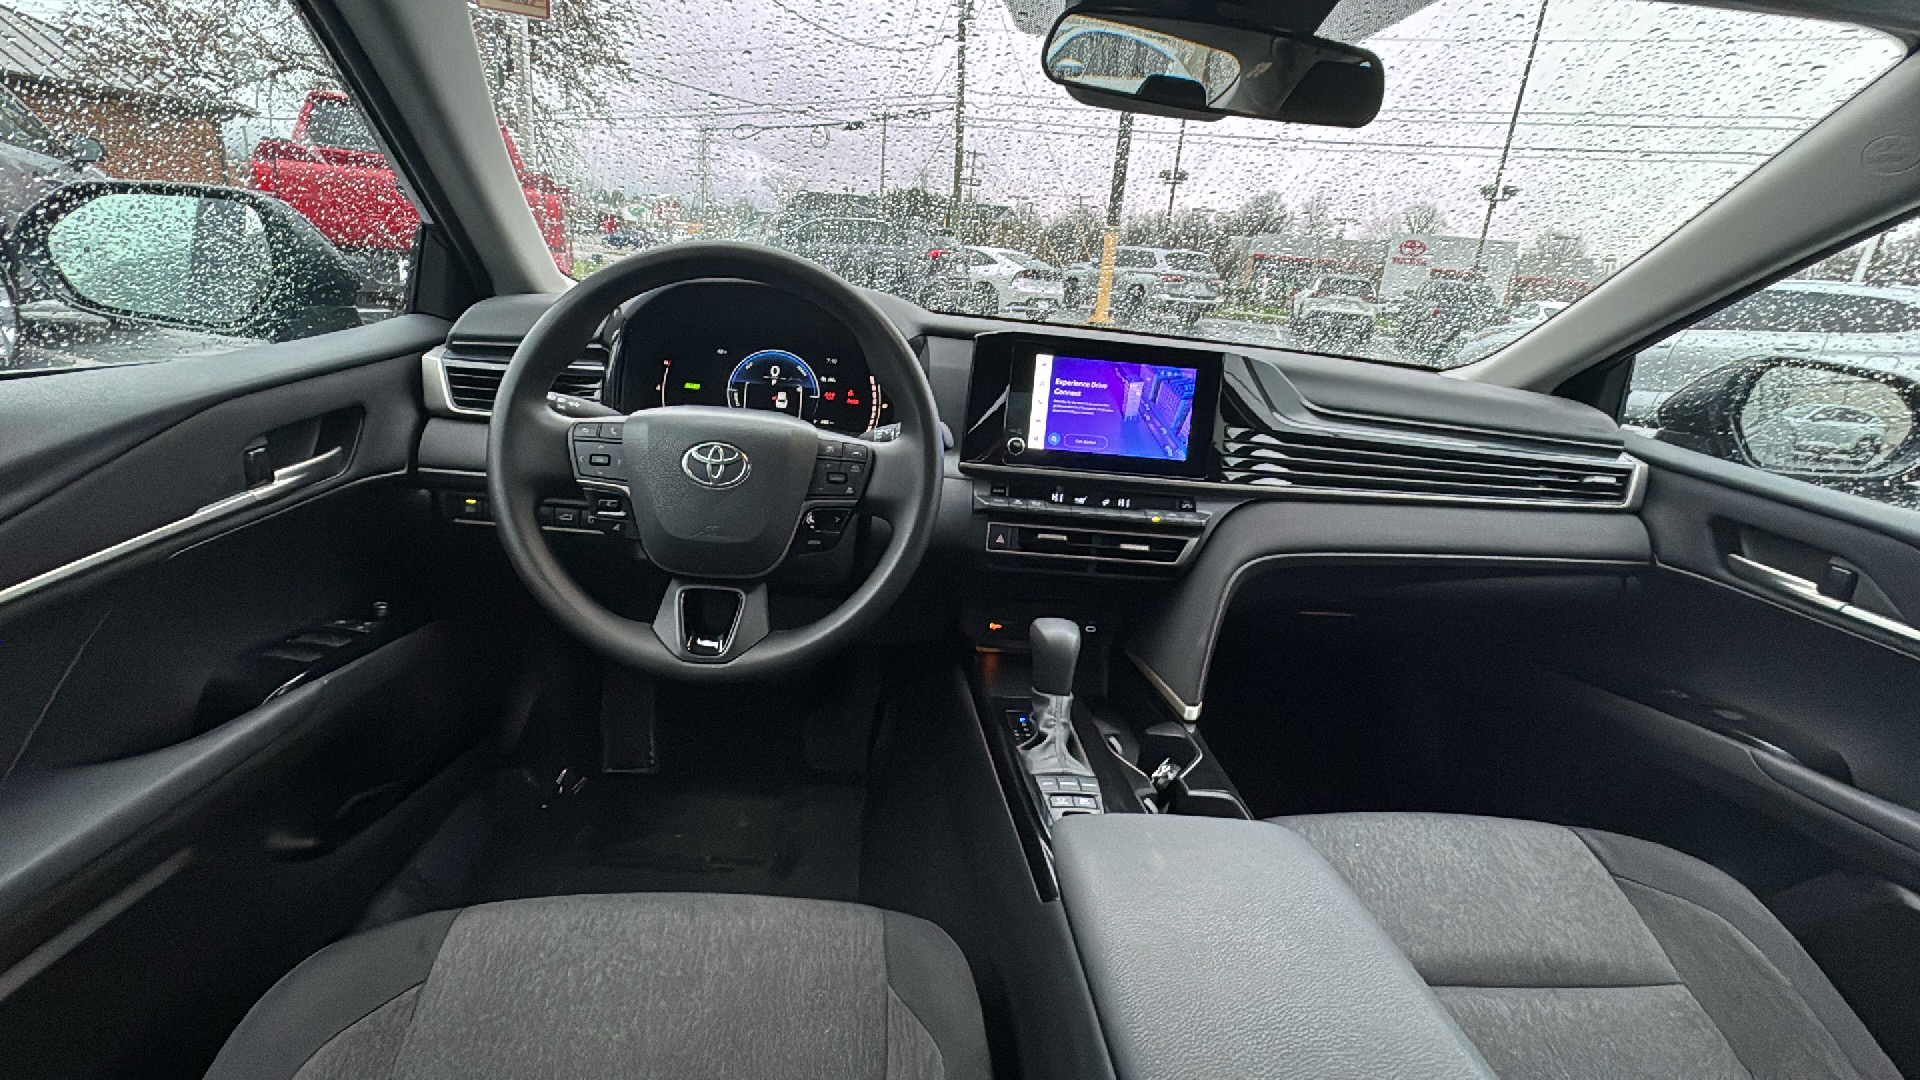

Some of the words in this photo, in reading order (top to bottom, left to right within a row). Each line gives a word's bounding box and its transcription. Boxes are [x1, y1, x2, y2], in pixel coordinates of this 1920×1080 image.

[770, 365, 780, 377] 0
[1055, 377, 1090, 388] Experience
[1091, 381, 1108, 389] Drive
[1053, 388, 1082, 397] Connect
